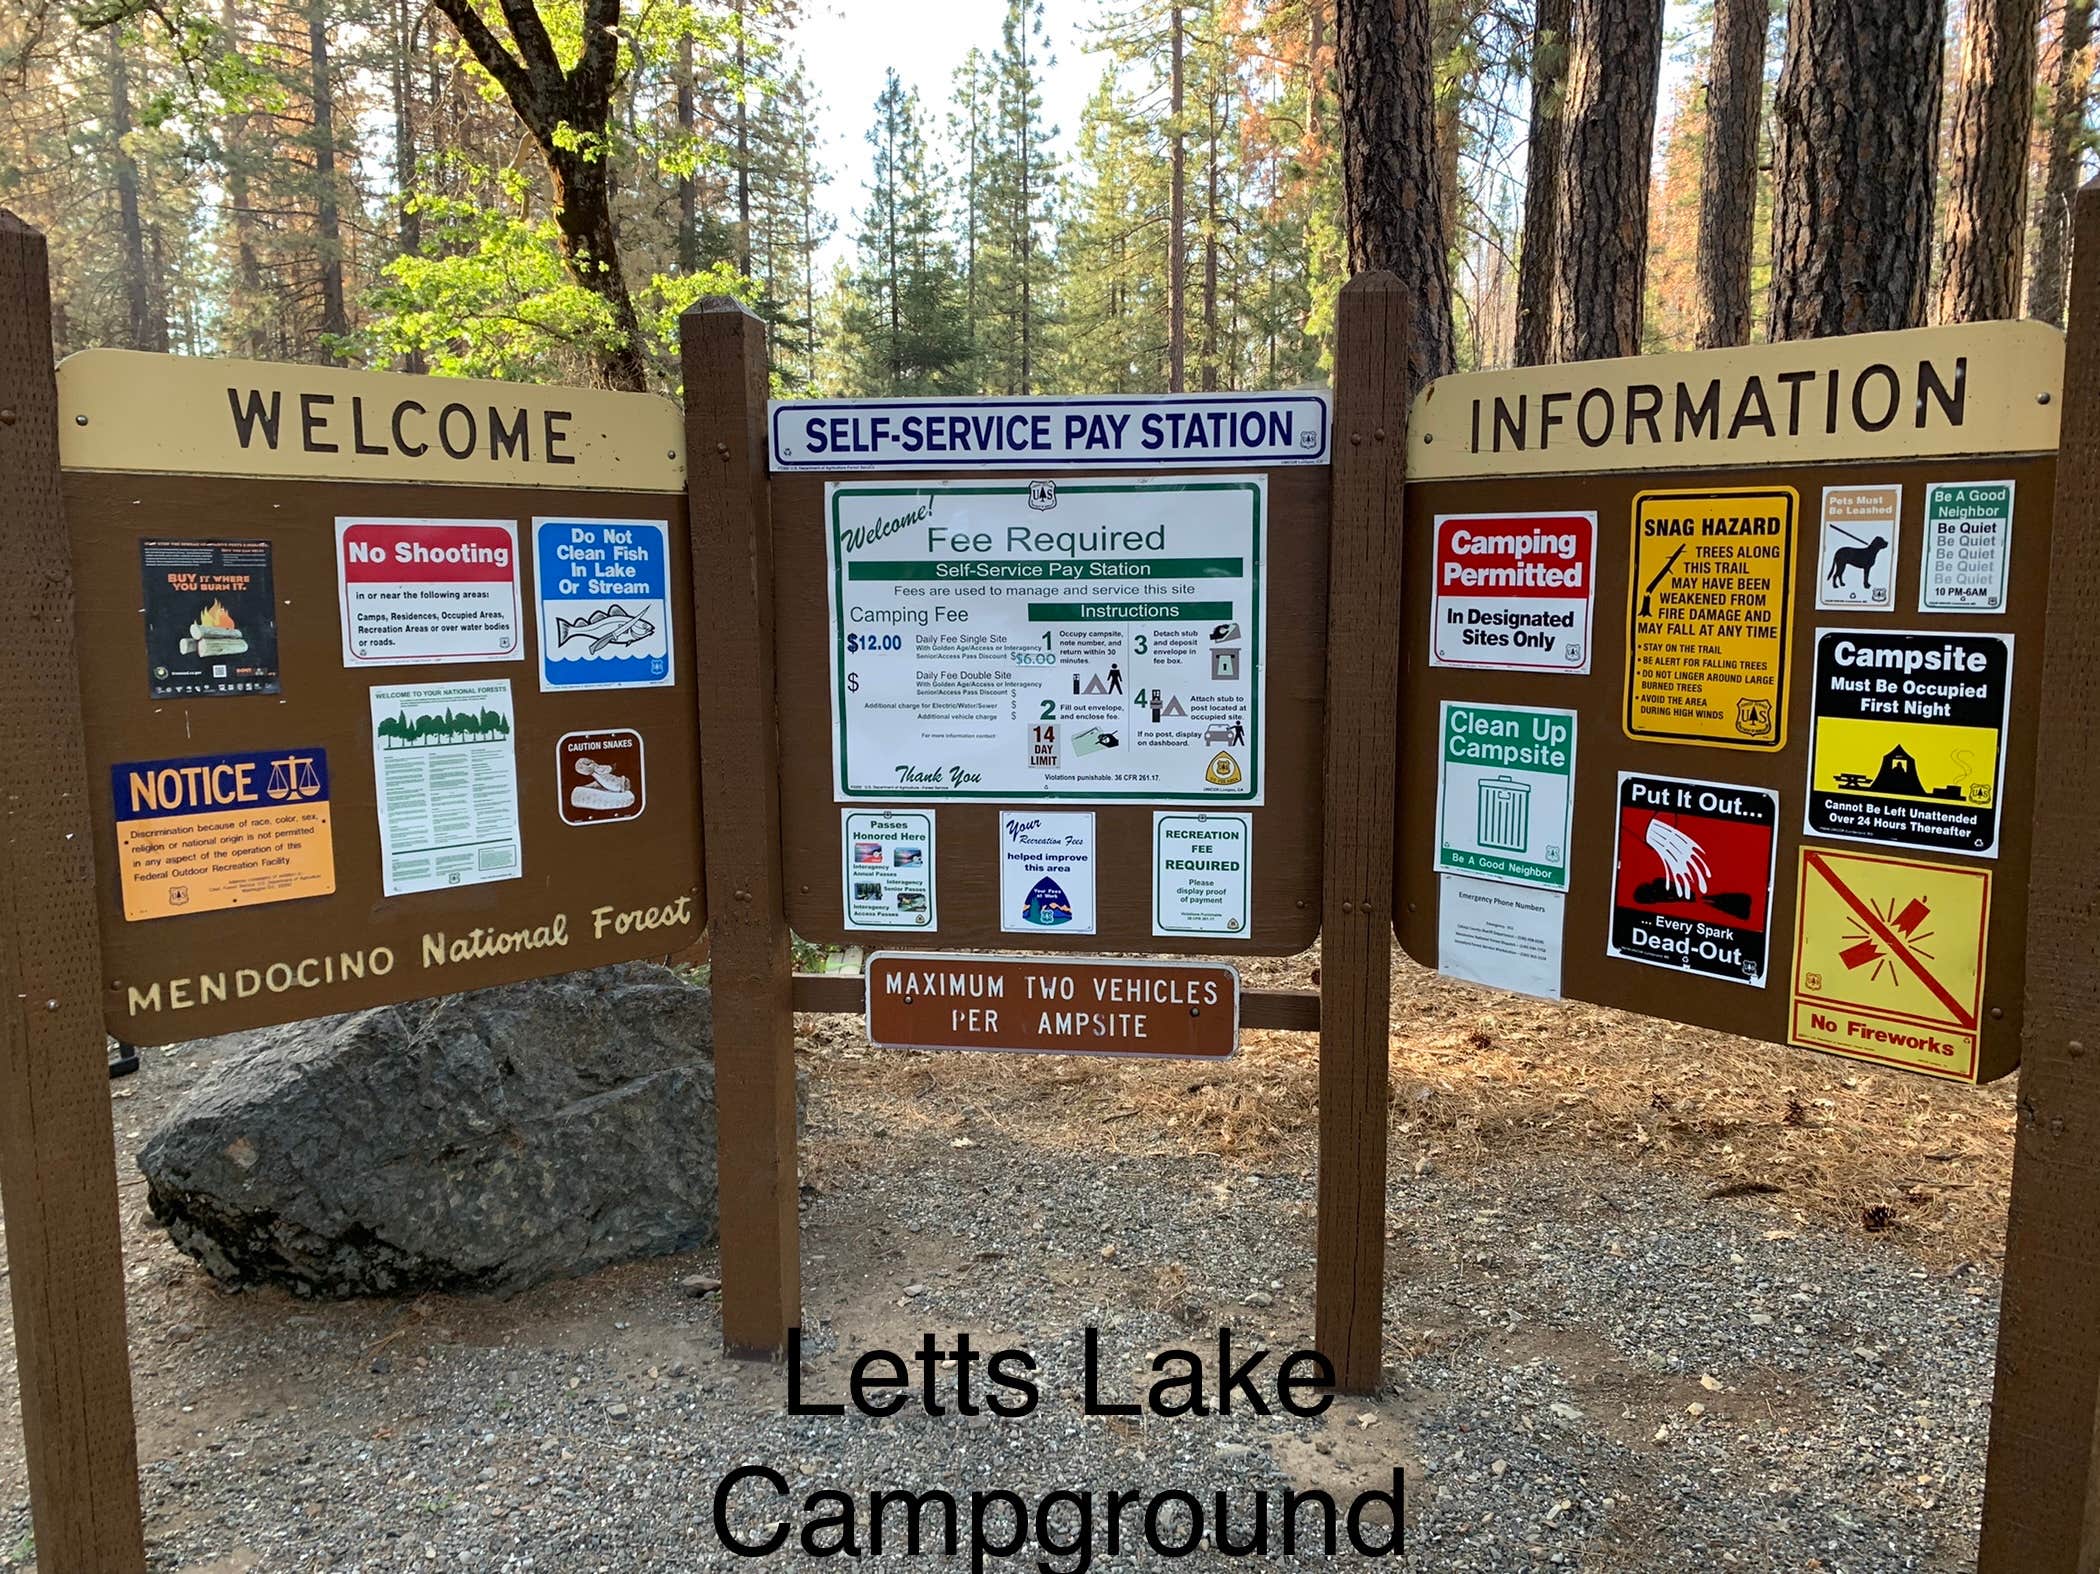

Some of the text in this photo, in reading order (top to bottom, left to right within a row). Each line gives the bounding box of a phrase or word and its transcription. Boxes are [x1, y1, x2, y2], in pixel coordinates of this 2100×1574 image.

[1471, 357, 1967, 453] INFORMATION
[227, 387, 576, 465] WELCOME
[805, 410, 1295, 453] SELF-SERVICE PAY STATION
[1830, 495, 1883, 505] Pets Must
[1935, 490, 2006, 502] Be A Good
[1829, 505, 1893, 515] Be Leashed
[1938, 505, 2000, 519] Neighbor
[840, 494, 935, 553] Welcome!
[1645, 517, 1781, 536] SNAG HAZARD
[1938, 522, 1996, 534] Be Quiet
[572, 528, 632, 544] Do Not
[928, 525, 1166, 557] Fee Required
[1452, 528, 1577, 559] Camping
[348, 542, 509, 567] No Shooting
[557, 545, 648, 561] Clean Fish
[1696, 546, 1780, 558] TREES ALONG
[571, 563, 636, 577] In Lake
[936, 562, 1151, 579] Self-Service Pay Station
[1444, 562, 1583, 587] Permitted
[1684, 562, 1750, 574] THIS TRAIL
[168, 573, 197, 583] BUY
[1672, 578, 1770, 590] MAY HAVE BEEN
[173, 583, 197, 591] YOU
[559, 579, 649, 594] Or Stream
[894, 583, 1195, 598] Fees are used to manage and service this site
[1948, 588, 1987, 596] PM-6AM
[1660, 593, 1766, 606] WEAKENED FROM
[357, 611, 504, 622] Camps, Residences, Occupied Areas,
[849, 607, 969, 626] Camping Fee
[1081, 604, 1179, 617] Instructions
[1448, 608, 1574, 629] In Designated
[1658, 608, 1771, 622] FIRE DAMAGE AND
[358, 625, 402, 633] Recreation
[484, 623, 509, 631] bodies
[1638, 622, 1778, 638] MAY FALL AT ANY TIME
[370, 638, 395, 646] roads.
[847, 633, 902, 653] $12.00
[1462, 629, 1555, 652] Sites Only
[1016, 653, 1056, 665] $6.00
[1834, 640, 1987, 674] Campsite
[1831, 677, 1987, 699] Must Be Occupied
[1860, 698, 1951, 718] First Night
[1033, 726, 1055, 743] 14
[1450, 710, 1566, 746] Clean Up
[568, 739, 632, 752] CAUTION SNAKES
[1035, 745, 1053, 754] DAY
[1449, 736, 1566, 768] Campsite
[1031, 756, 1057, 766] LIMIT
[895, 765, 982, 788] Thank You
[129, 762, 258, 812] NOTICE
[1632, 783, 1762, 818] Put It Out...
[1825, 800, 1977, 825] Cannot Be Left Unattended
[870, 821, 908, 829] Passes
[1006, 818, 1041, 842] Your
[1829, 813, 1854, 824] Over
[1858, 816, 1870, 826] 24
[1874, 818, 1906, 831] Hours
[1911, 822, 1971, 838] Thereafter
[853, 832, 926, 841] Honored Here
[1019, 835, 1083, 846] Recreation Fees
[1165, 830, 1239, 840] RECREATION
[1192, 845, 1213, 853] FEE
[1007, 853, 1088, 862] helped improve
[1165, 860, 1240, 871] REQUIRED
[134, 857, 290, 882] Federal Outdoor Recreation Facility
[1024, 864, 1044, 872] this
[1452, 852, 1552, 880] Be A Good Neighbor
[1656, 916, 1693, 934] Every
[1697, 923, 1734, 941] Spark
[1632, 927, 1742, 966] Dead-Out
[127, 897, 692, 1017] MENDOCINO National Forest
[886, 972, 1218, 1005] MAXIMUM TWO VEHICLES
[952, 1009, 998, 1033] PER
[1811, 1013, 1955, 1057] No Fireworks
